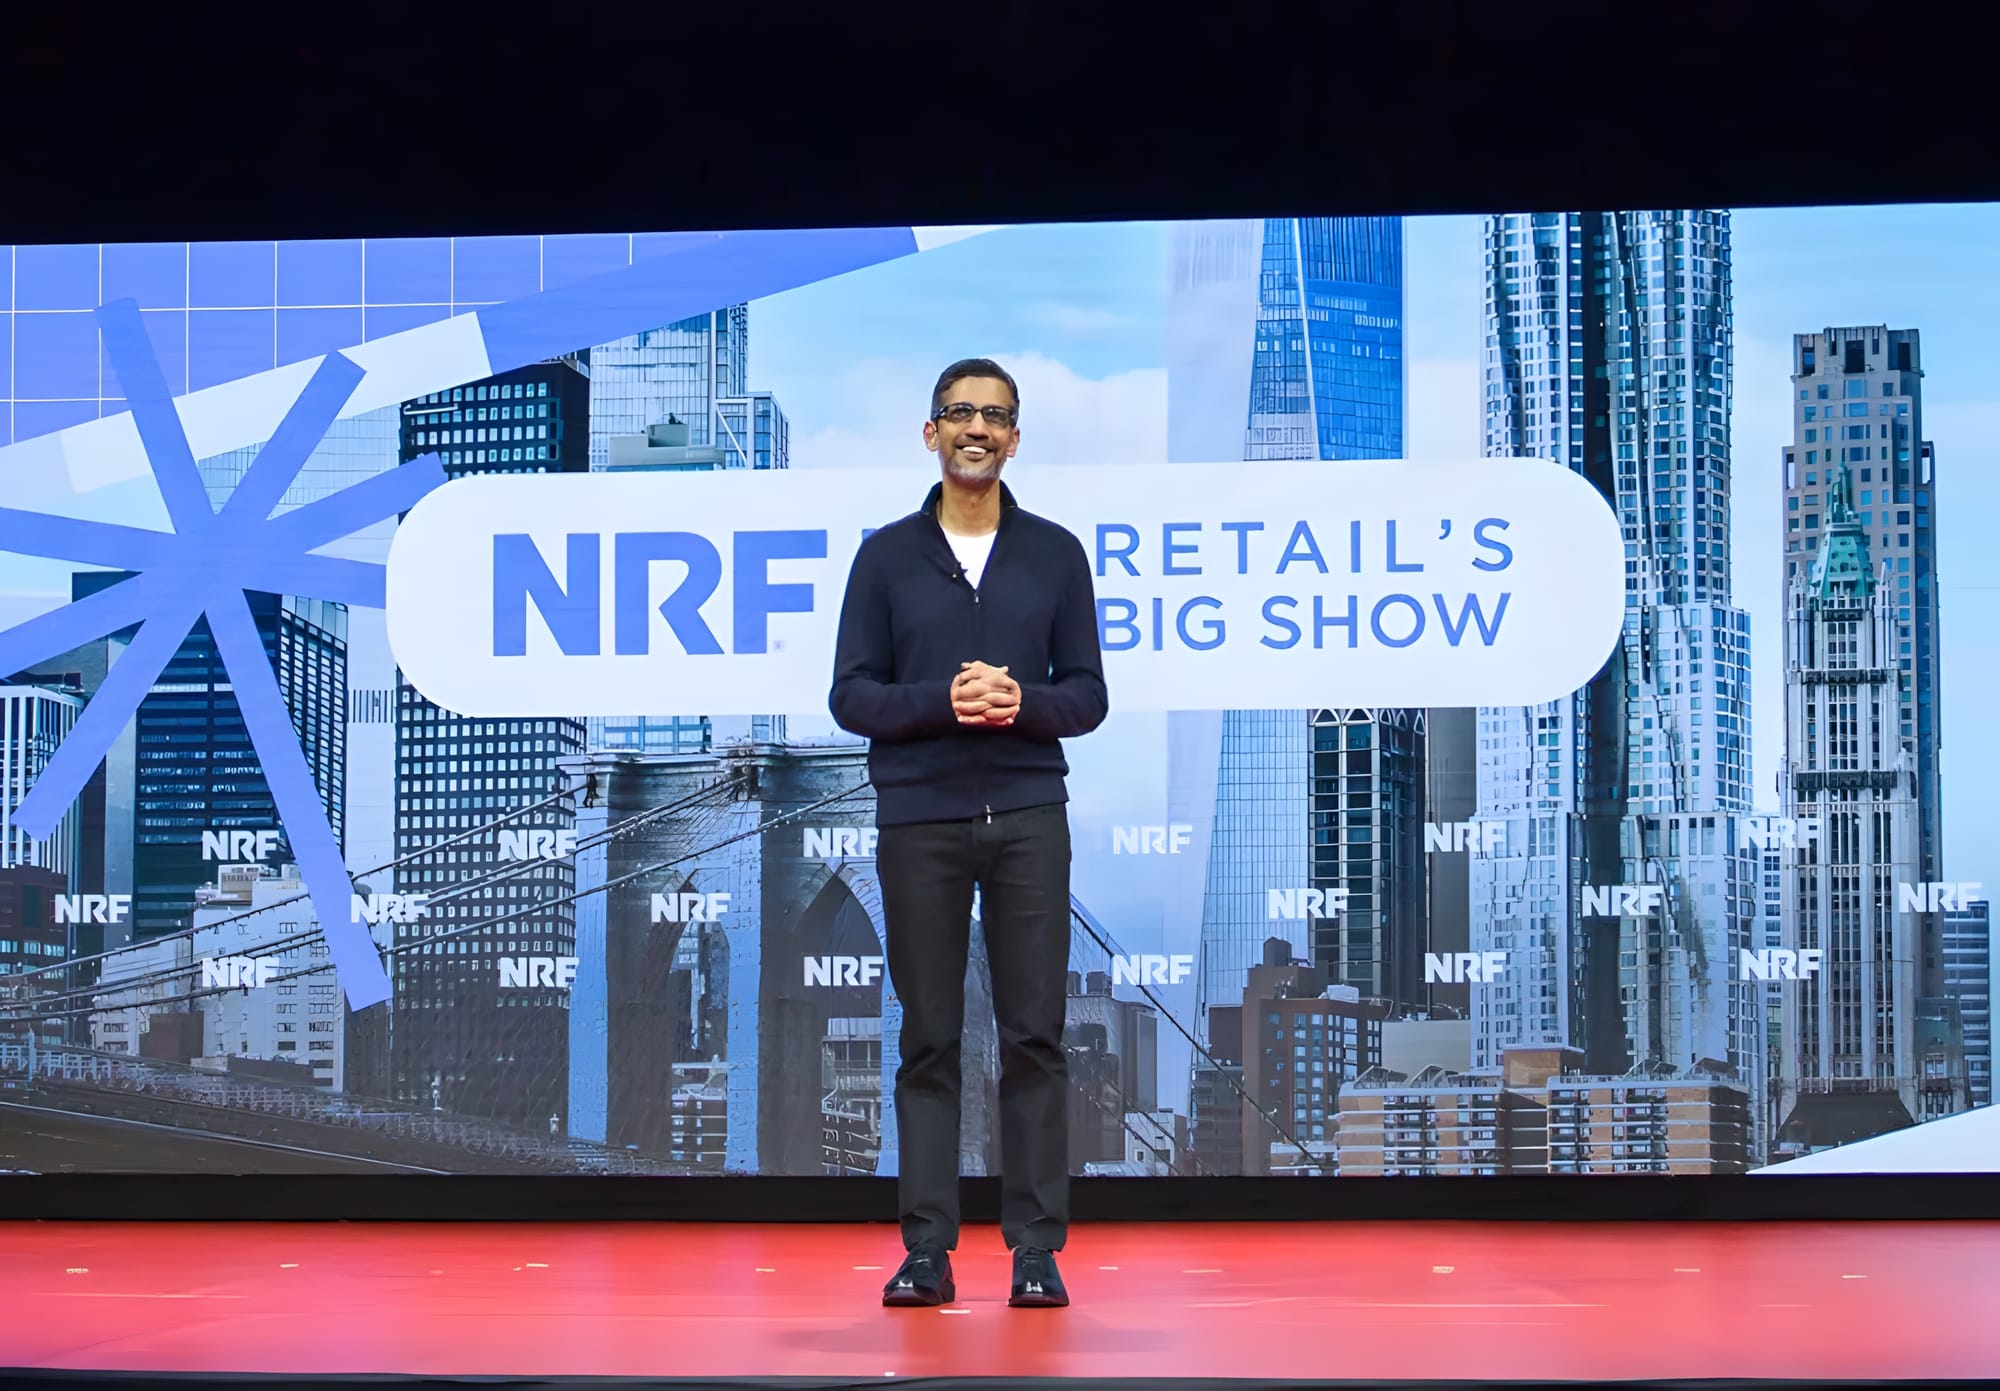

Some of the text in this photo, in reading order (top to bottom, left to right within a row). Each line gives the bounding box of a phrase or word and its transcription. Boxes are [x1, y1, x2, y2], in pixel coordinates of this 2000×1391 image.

[1096, 517, 1514, 577] RETAIL'S
[493, 529, 828, 656] NRF
[1097, 592, 1512, 651] BIG SHOW
[202, 830, 280, 861] NRF
[499, 829, 578, 861] NRF
[803, 827, 879, 857] NRF
[1112, 824, 1193, 854] NRF
[1424, 822, 1505, 852] NRF
[1740, 817, 1822, 848] NRF
[55, 894, 132, 924] NRF
[350, 893, 430, 923] NRF
[651, 892, 732, 922] NRF
[1268, 888, 1350, 919] NRF
[1582, 885, 1665, 916] NRF
[1899, 881, 1982, 912] NRF
[202, 957, 280, 989] NRF
[500, 957, 579, 988] NRF
[803, 955, 884, 987] NRF
[1112, 954, 1193, 985] NRF
[1424, 951, 1506, 983] NRF
[1740, 948, 1823, 979] NRF
